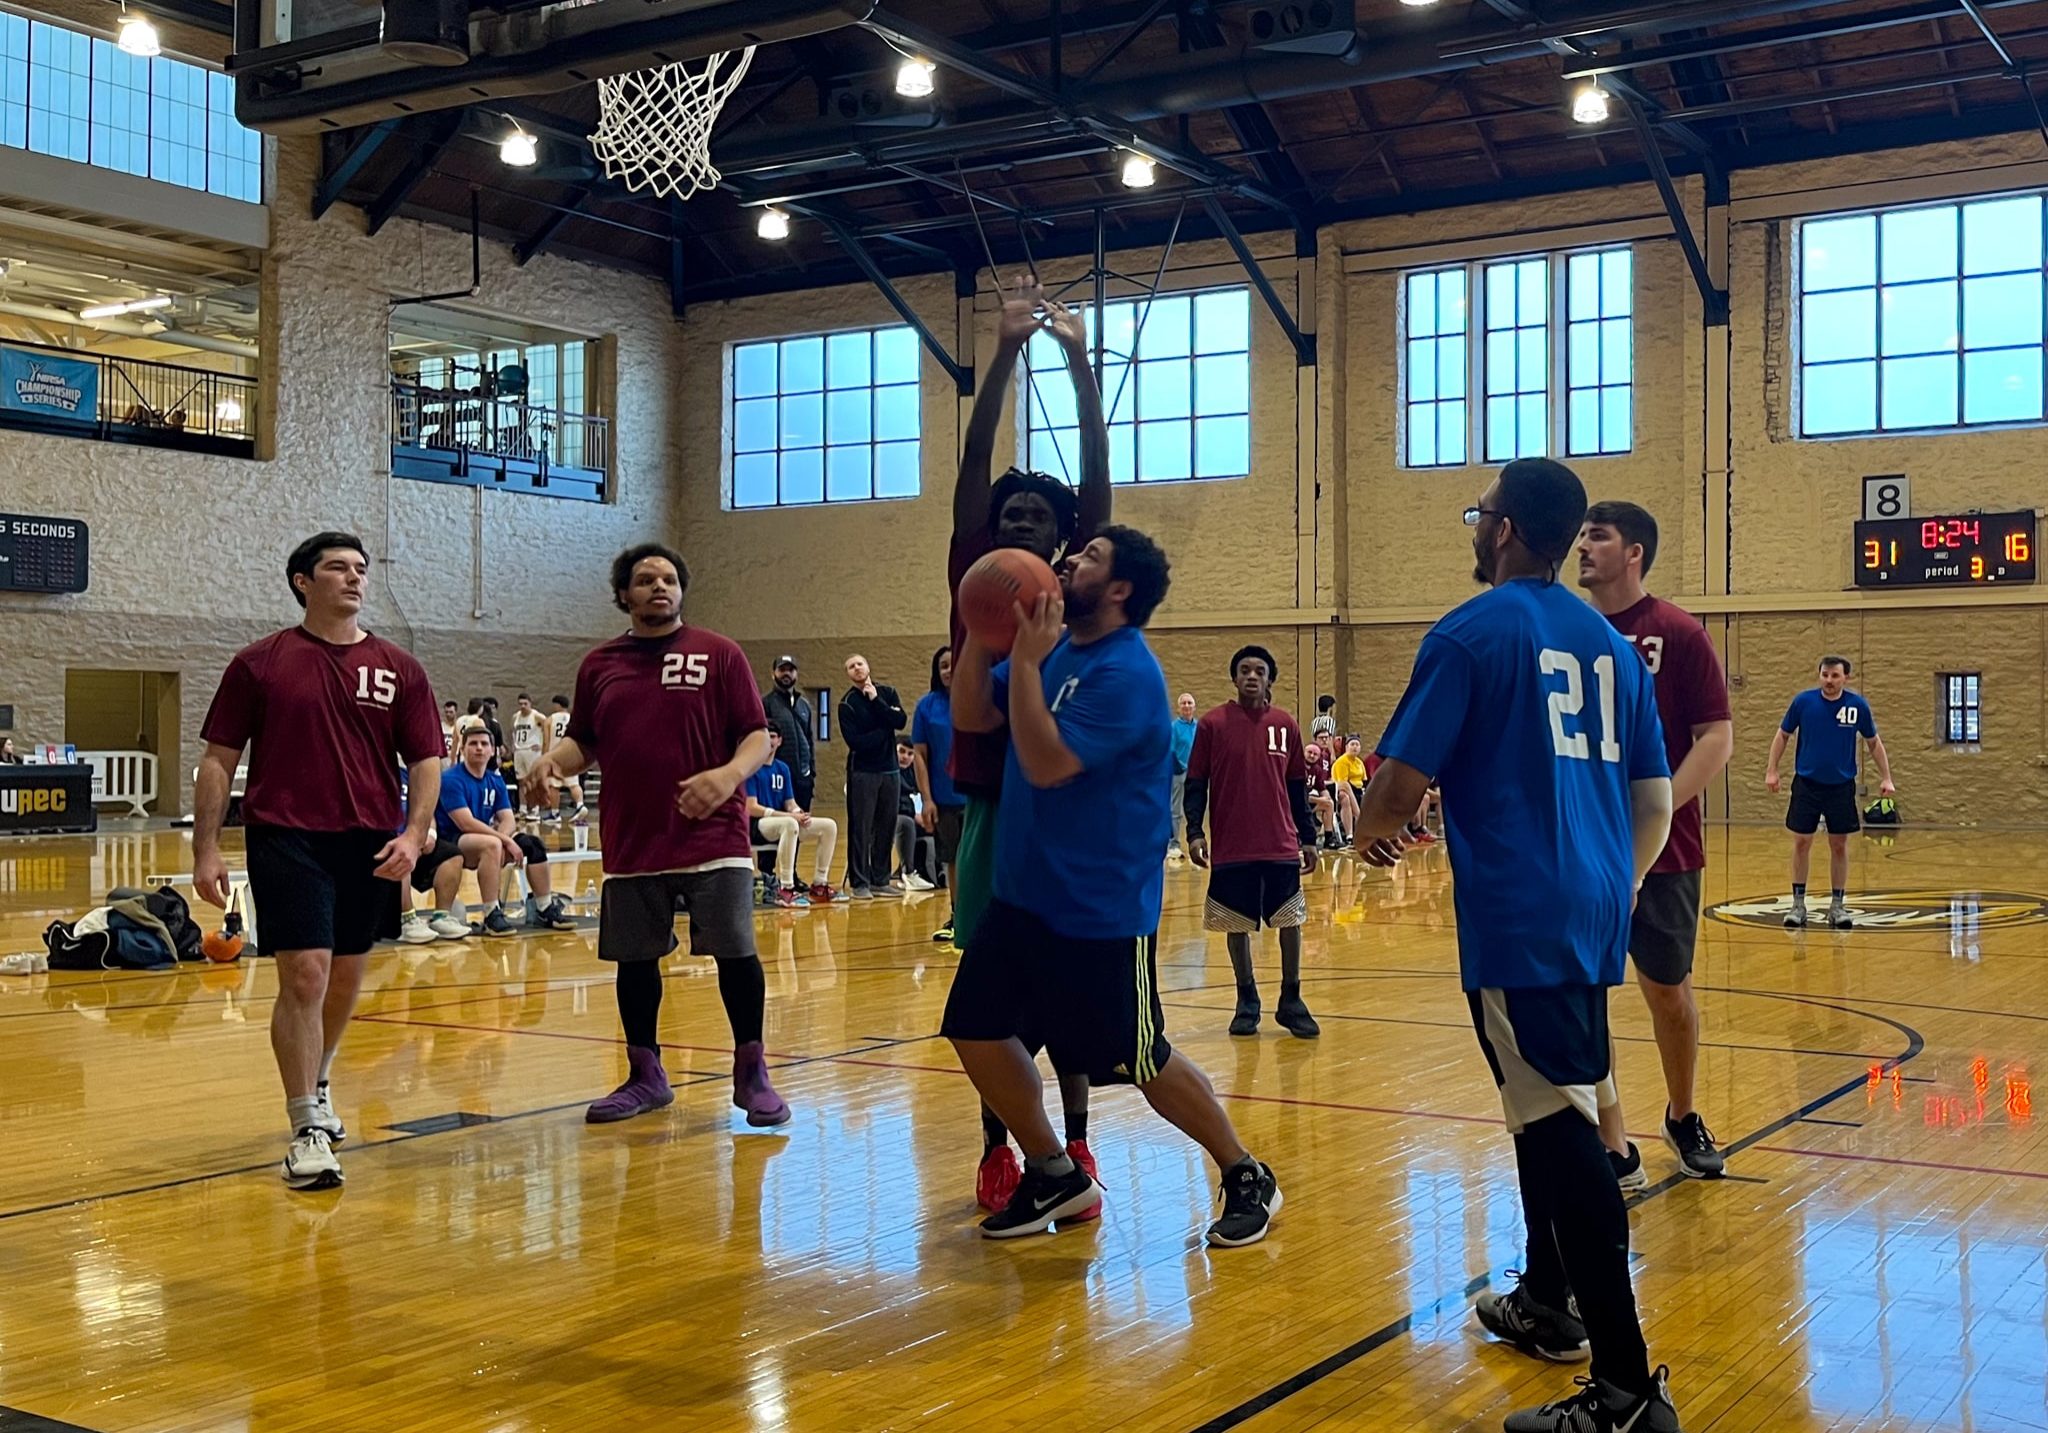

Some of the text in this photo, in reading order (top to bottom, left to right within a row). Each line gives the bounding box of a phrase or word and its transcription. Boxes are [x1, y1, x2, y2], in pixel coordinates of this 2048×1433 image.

[15, 379, 82, 403] CHAMPIONSHIP
[36, 373, 66, 386] NIRSA
[33, 394, 62, 408] SERIES
[1876, 484, 1901, 517] 8
[12, 521, 76, 539] SECONDS
[1921, 519, 1981, 549] 8:24
[2003, 532, 2029, 562] 16
[1925, 565, 1960, 579] period
[1970, 556, 1984, 579] 3
[1622, 634, 1664, 675] 3
[661, 653, 709, 686] 25
[356, 666, 397, 704] 15
[1539, 648, 1620, 763] 21
[1835, 706, 1858, 724] 40
[518, 730, 527, 743] 13
[1267, 726, 1287, 753] 11
[771, 773, 784, 790] 10
